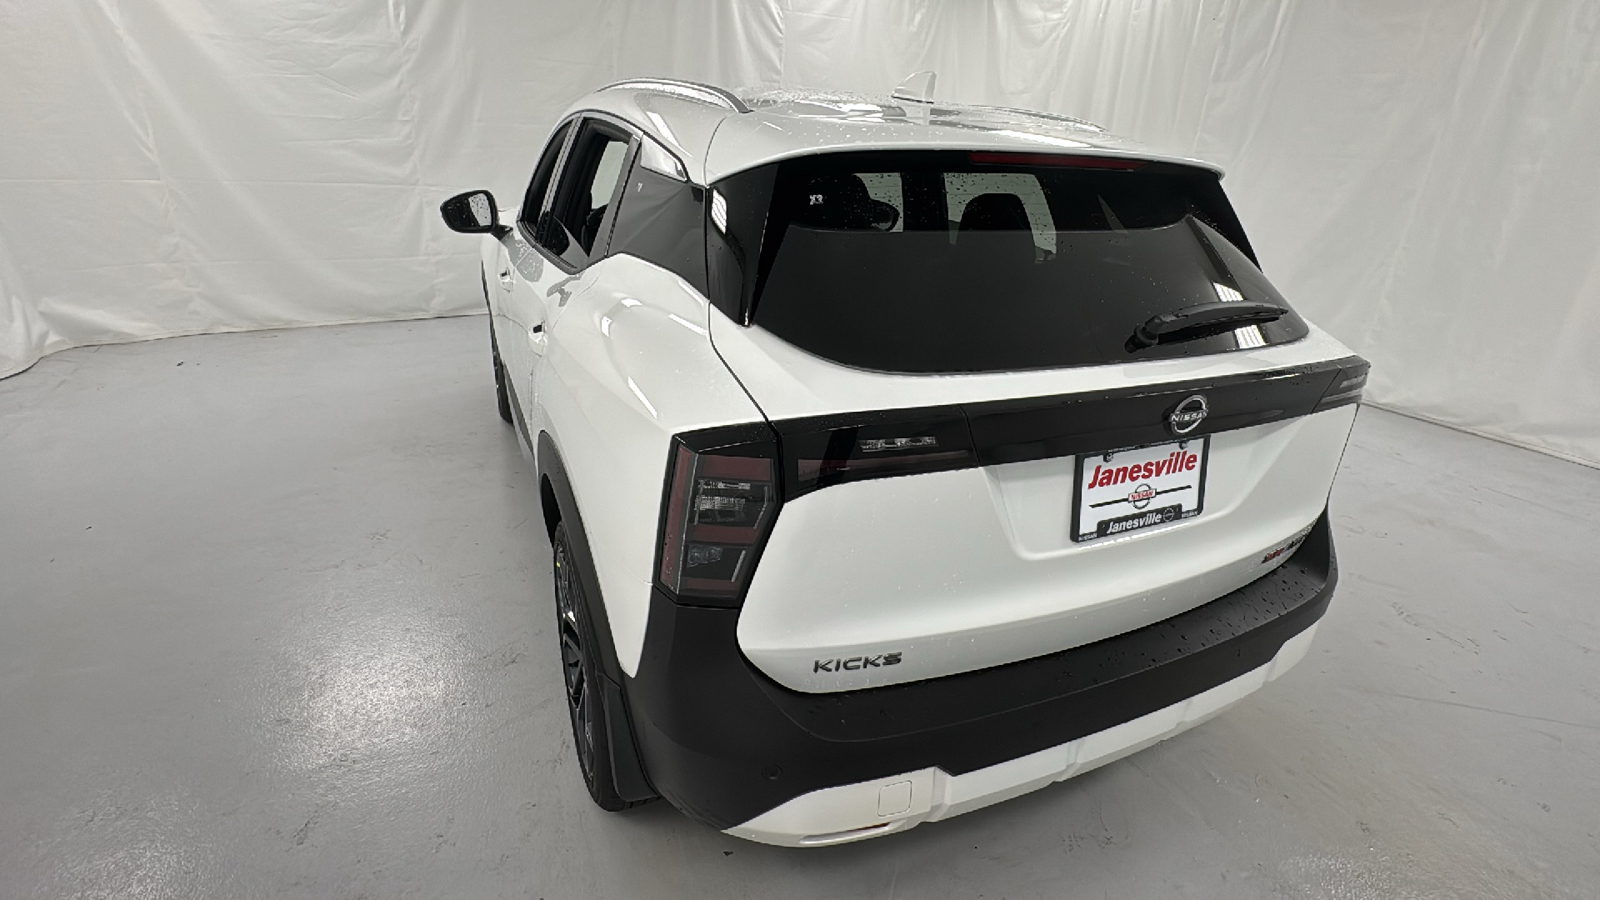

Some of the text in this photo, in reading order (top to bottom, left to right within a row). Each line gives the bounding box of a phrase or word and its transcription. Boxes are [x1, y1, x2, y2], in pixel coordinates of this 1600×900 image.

[1170, 410, 1208, 422] NISSAN
[1087, 450, 1198, 490] Janesville
[1130, 490, 1154, 501] NISSAN
[1107, 512, 1163, 534] Janesville
[813, 651, 902, 673] KICKS
